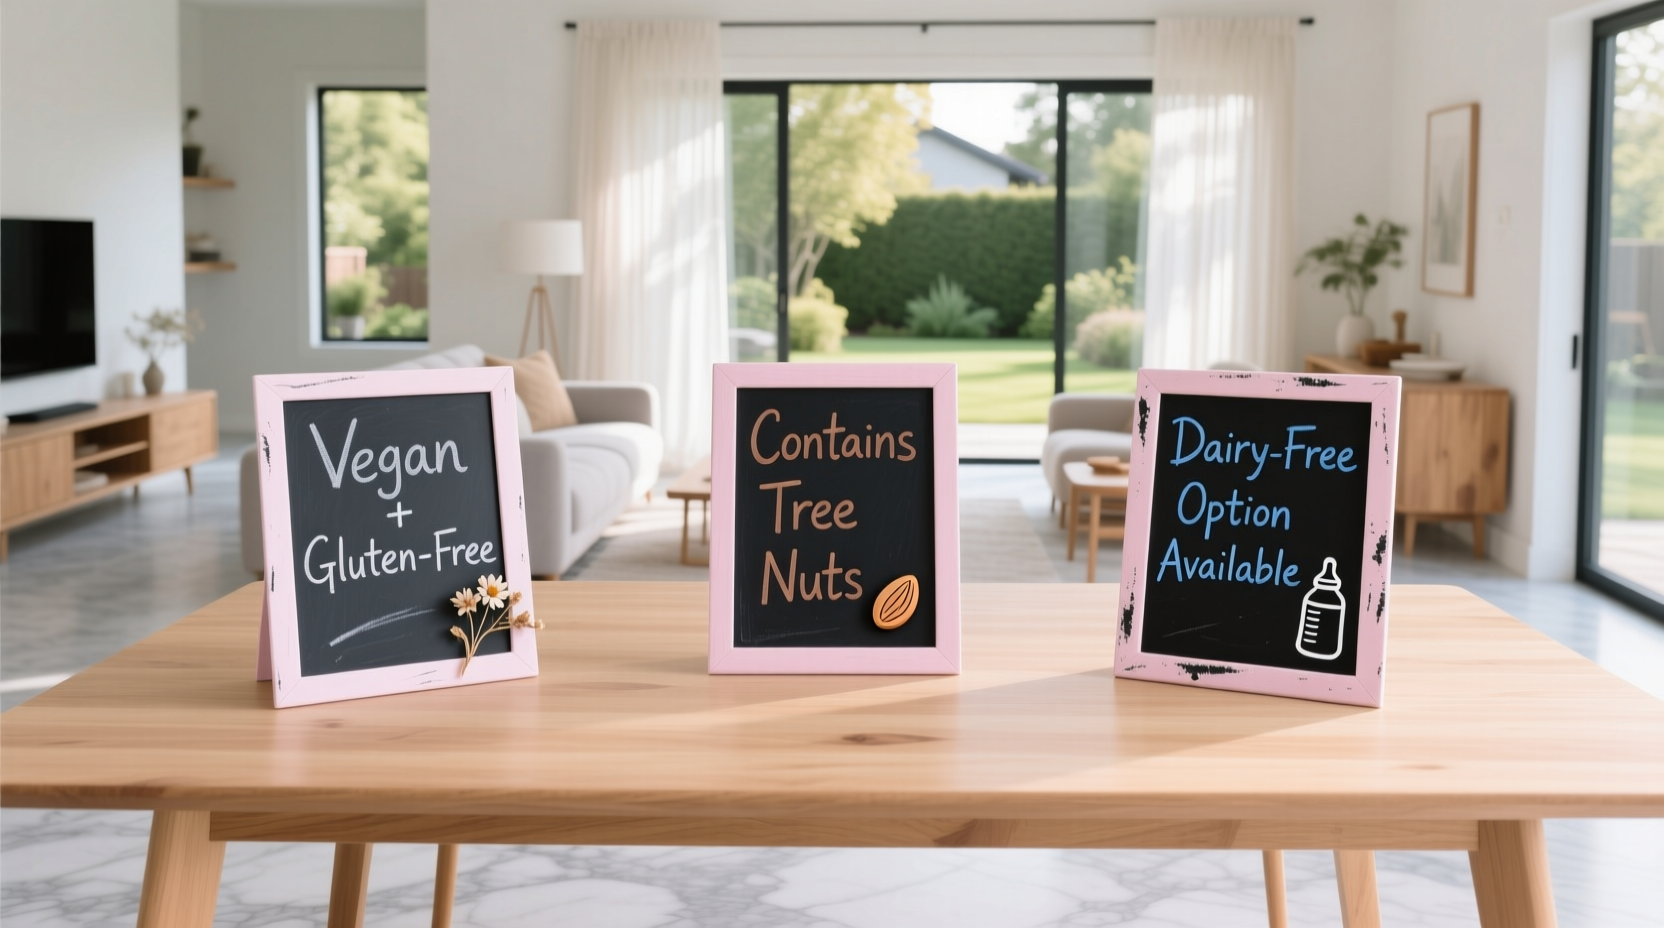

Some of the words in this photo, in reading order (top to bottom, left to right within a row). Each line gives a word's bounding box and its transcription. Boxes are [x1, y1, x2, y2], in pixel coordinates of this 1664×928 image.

[309, 417, 468, 500] Vegan
[750, 408, 917, 465] Contains
[1170, 416, 1358, 481] Dairy-Free
[386, 501, 413, 528] +
[759, 480, 858, 534] Tree
[1177, 481, 1291, 540] Option
[304, 527, 497, 594] Gluten-Free
[761, 548, 863, 606] Nuts
[1156, 538, 1301, 587] Available
